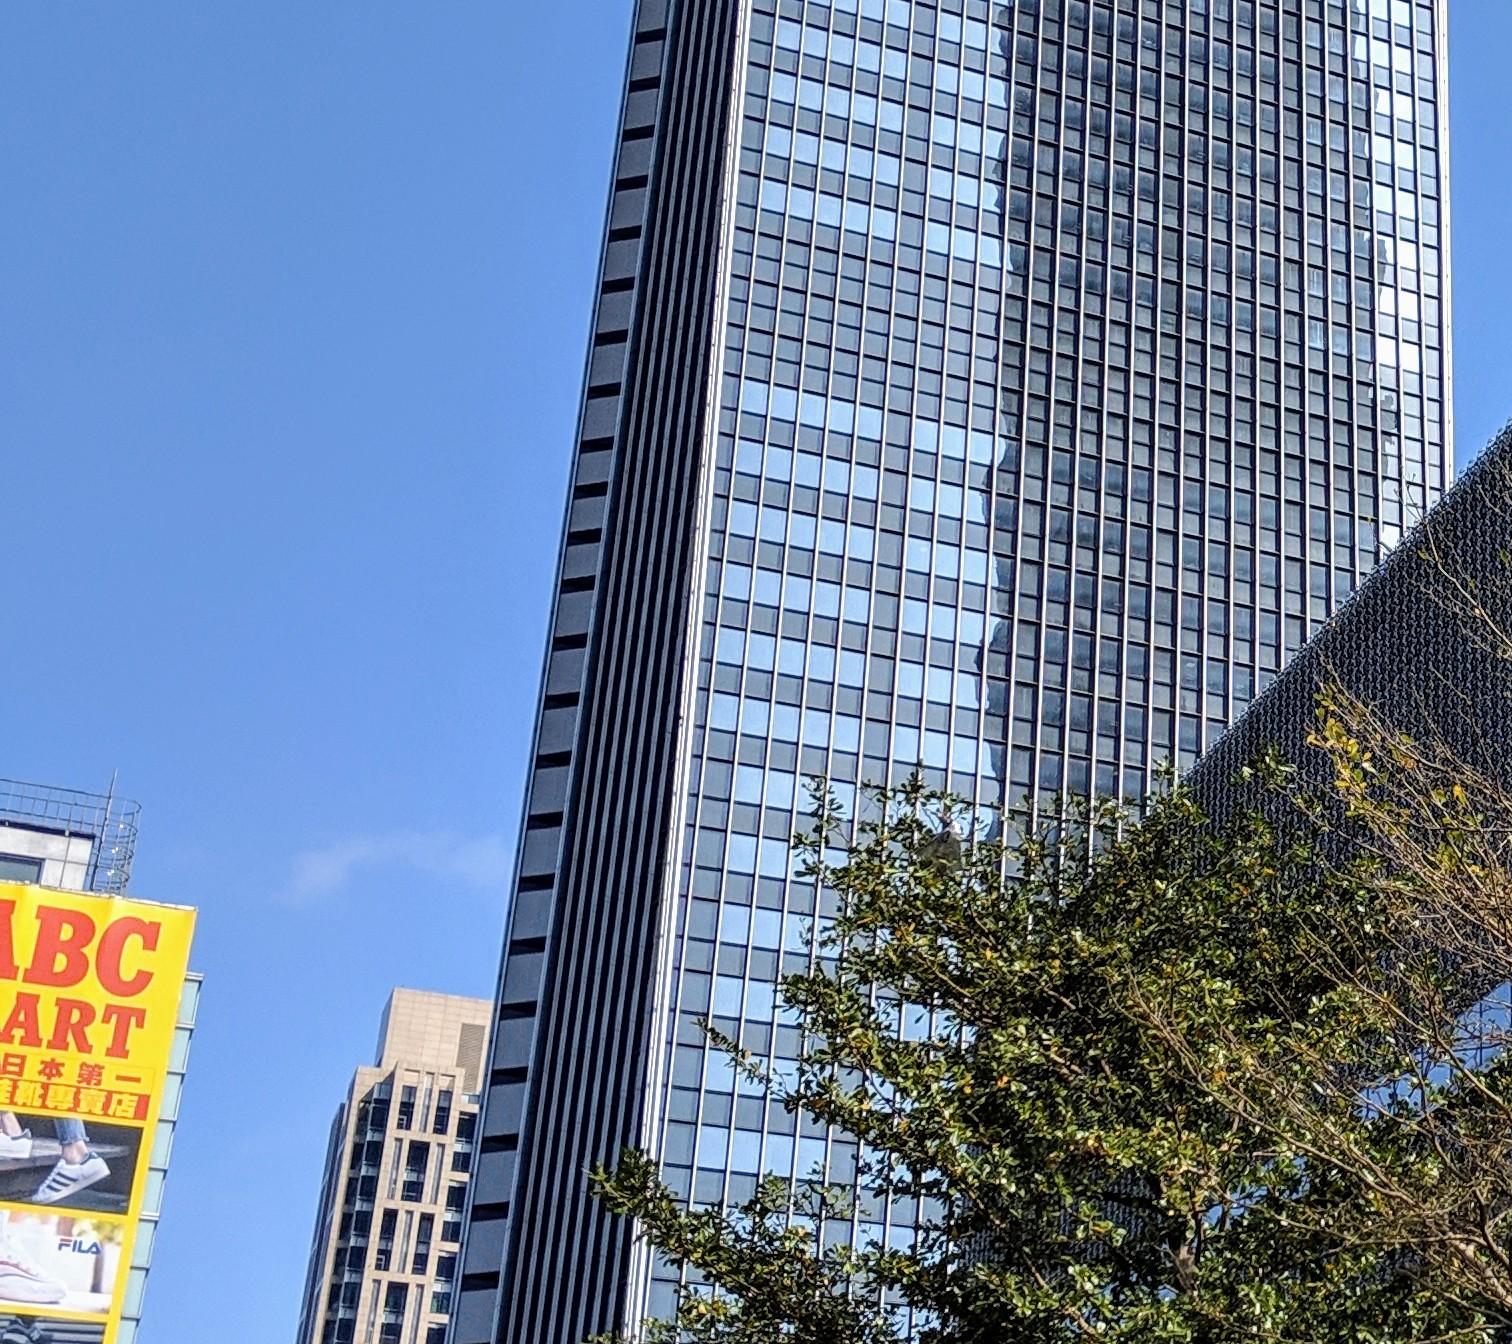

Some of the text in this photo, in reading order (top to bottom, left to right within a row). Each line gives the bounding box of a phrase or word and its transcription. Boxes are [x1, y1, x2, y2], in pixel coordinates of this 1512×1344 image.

[0, 899, 162, 998] BC
[1, 1053, 142, 1087] 日本第一
[58, 1238, 102, 1255] FILA
